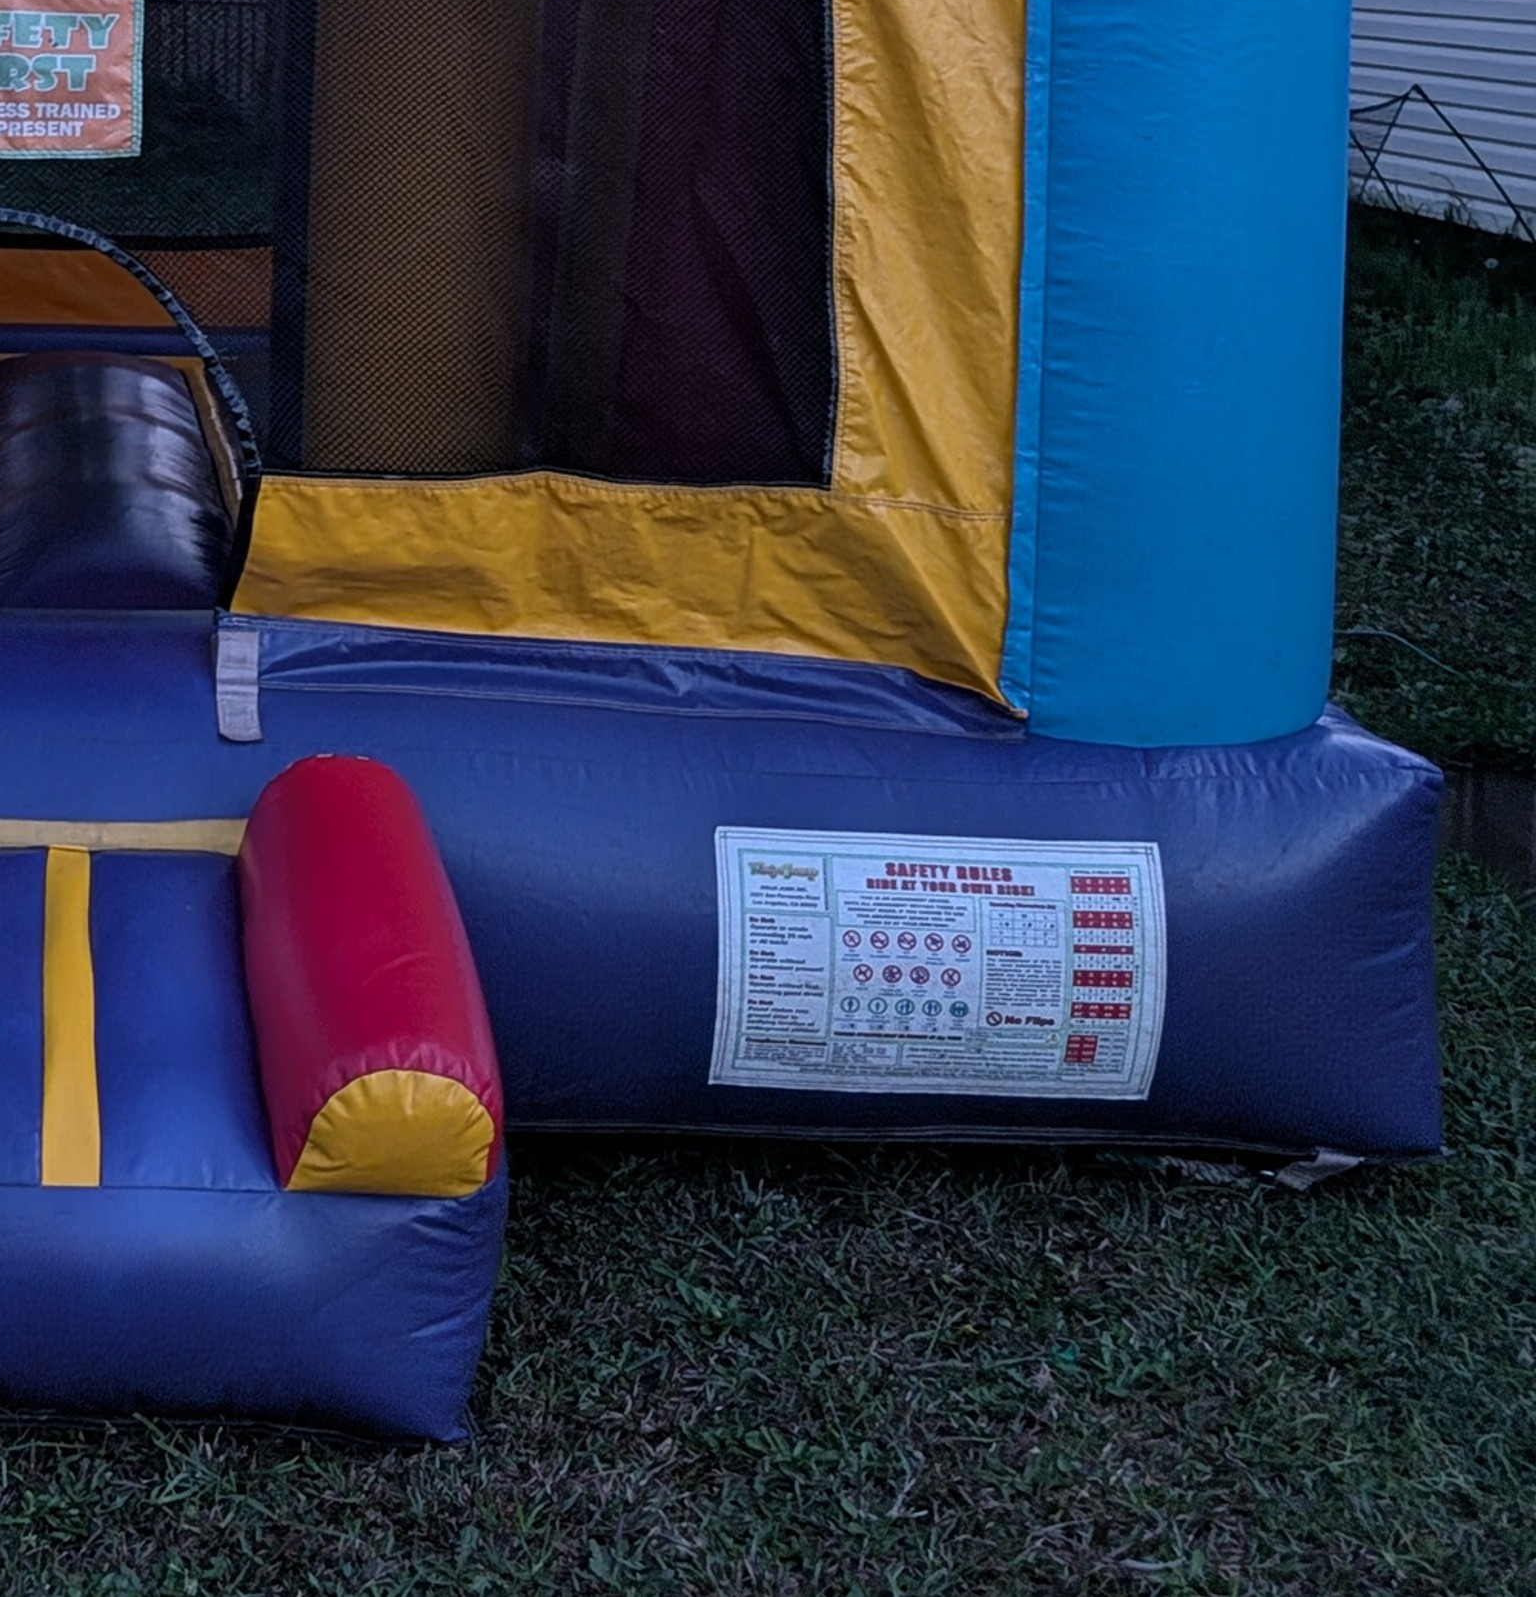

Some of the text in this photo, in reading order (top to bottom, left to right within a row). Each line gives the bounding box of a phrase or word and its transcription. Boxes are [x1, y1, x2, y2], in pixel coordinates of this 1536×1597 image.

[35, 103, 122, 120] TRAINED
[884, 862, 1013, 882] SAFETY RULES
[920, 880, 957, 893] YOUR
